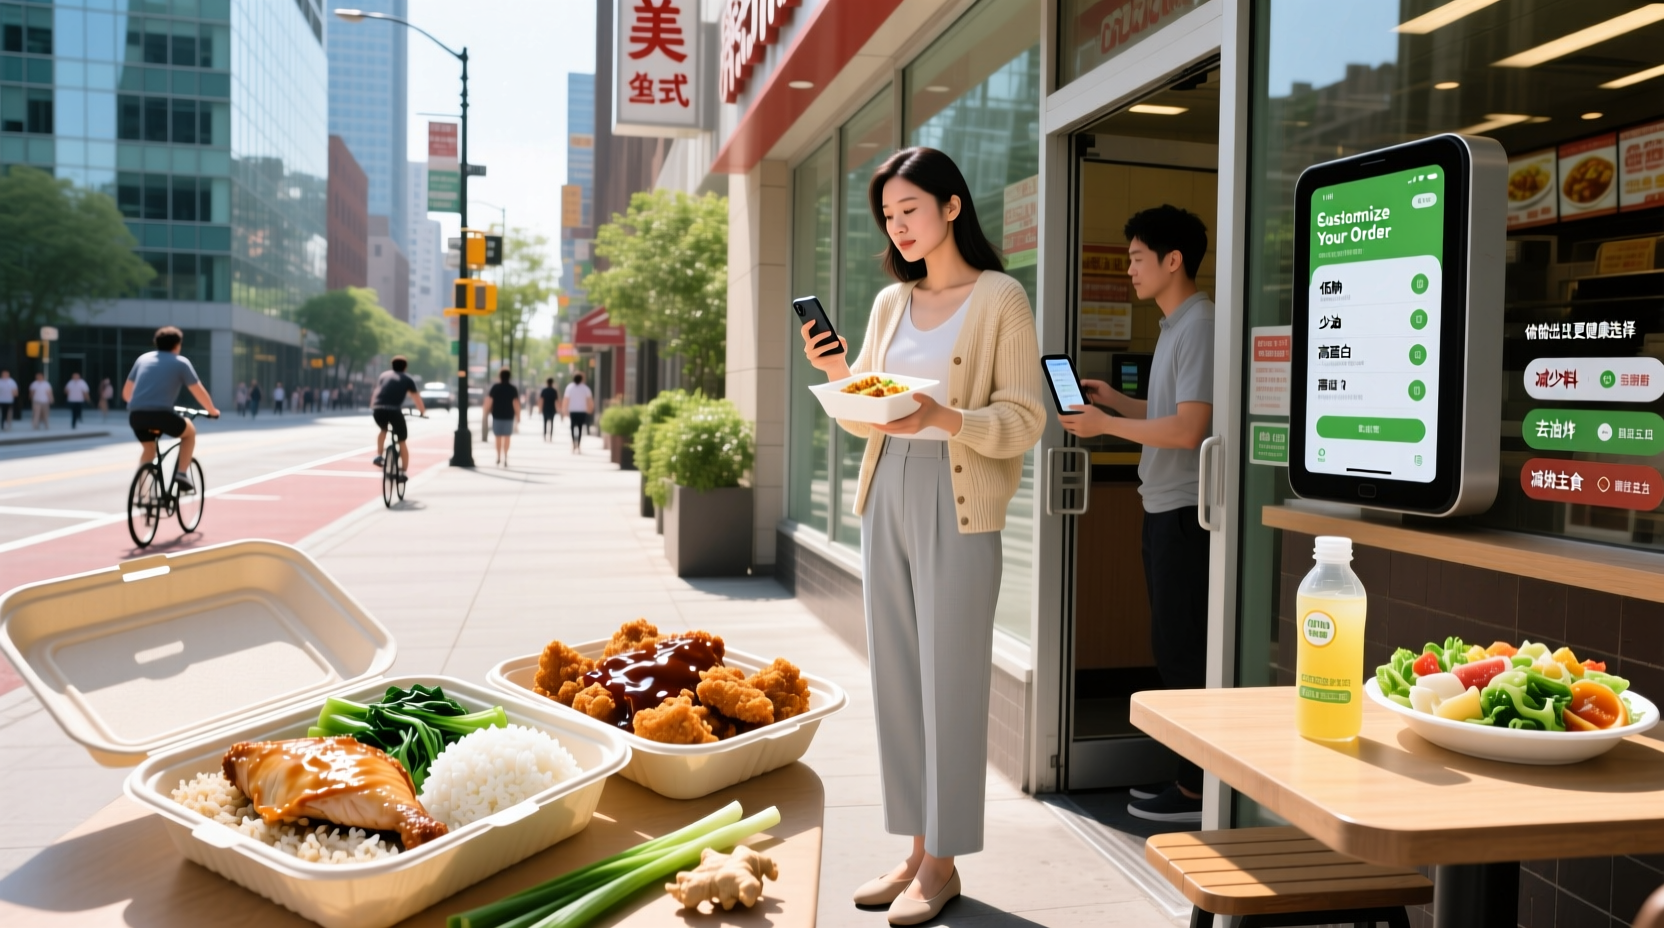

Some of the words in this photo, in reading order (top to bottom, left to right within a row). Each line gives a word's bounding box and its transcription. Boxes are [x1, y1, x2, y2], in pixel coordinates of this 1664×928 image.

[628, 0, 687, 63] 美
[1317, 231, 1348, 246] Your
[1350, 224, 1392, 242] Order
